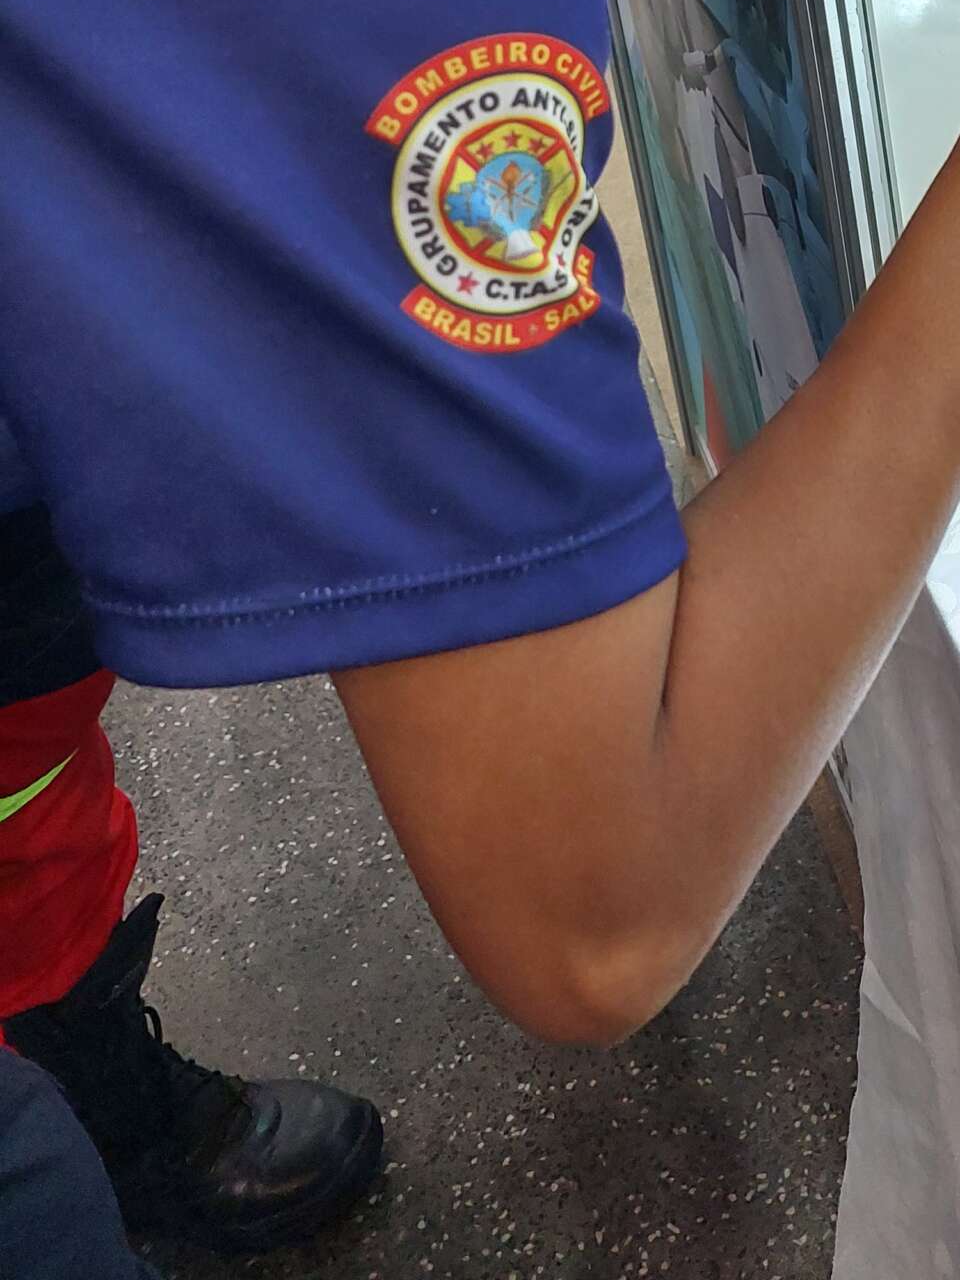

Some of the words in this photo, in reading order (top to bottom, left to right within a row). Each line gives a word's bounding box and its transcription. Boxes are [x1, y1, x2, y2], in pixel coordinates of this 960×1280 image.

[376, 41, 551, 140] BOMBEIRO
[555, 54, 605, 118] CIVIL
[407, 91, 501, 277] GRUPAMENTO
[413, 297, 521, 346] BRASIL
